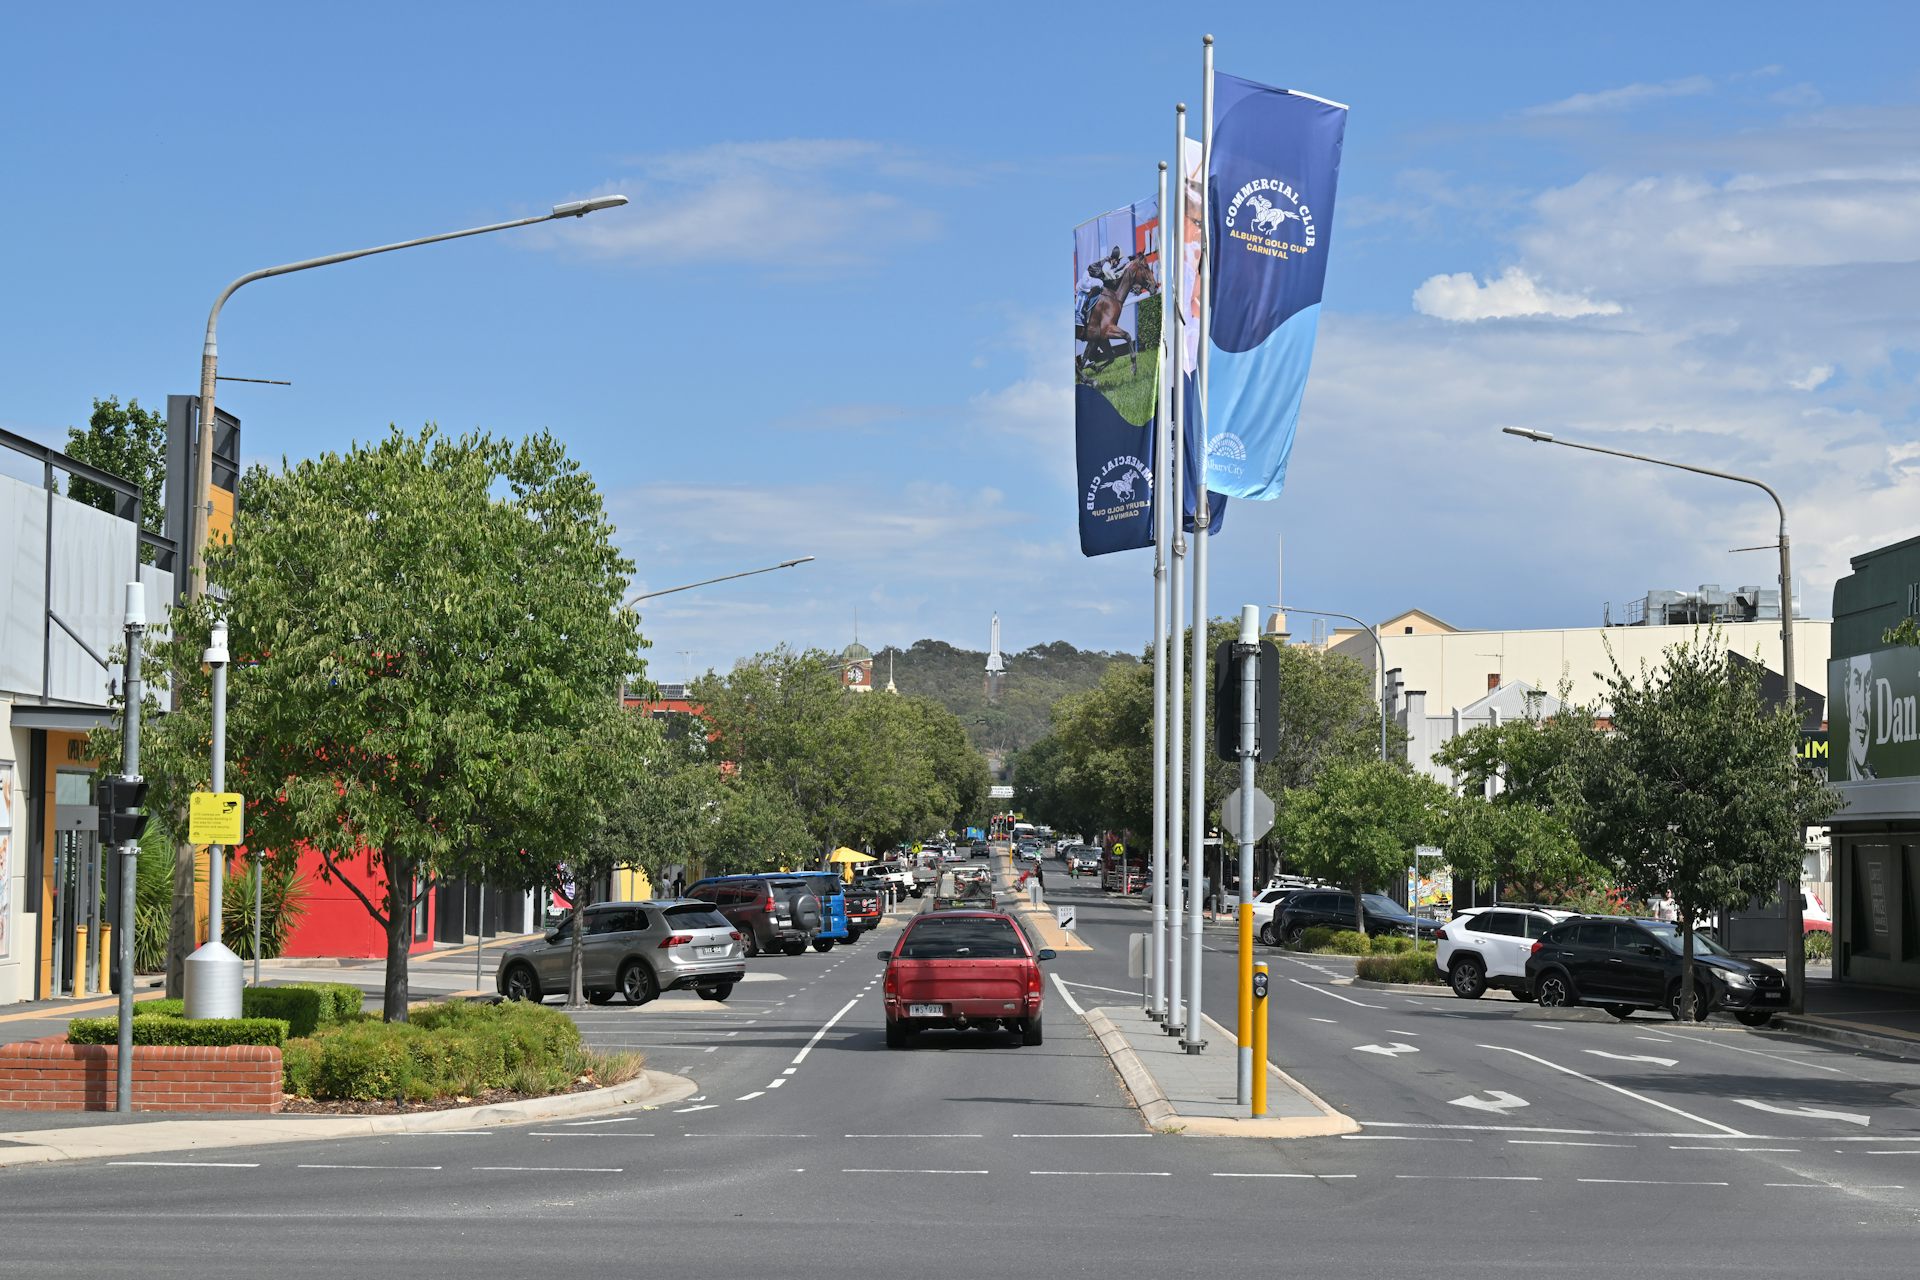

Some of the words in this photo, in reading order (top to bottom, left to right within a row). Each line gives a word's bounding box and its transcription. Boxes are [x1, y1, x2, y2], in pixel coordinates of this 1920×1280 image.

[1225, 178, 1299, 228] COMMERCIAL
[1299, 205, 1316, 247] CLUB
[1229, 229, 1264, 244] ALBURY
[1264, 238, 1289, 250] GOLD
[1290, 243, 1308, 254] CUP
[1246, 243, 1289, 260] CARNIVAL
[1876, 677, 1918, 745] Dan
